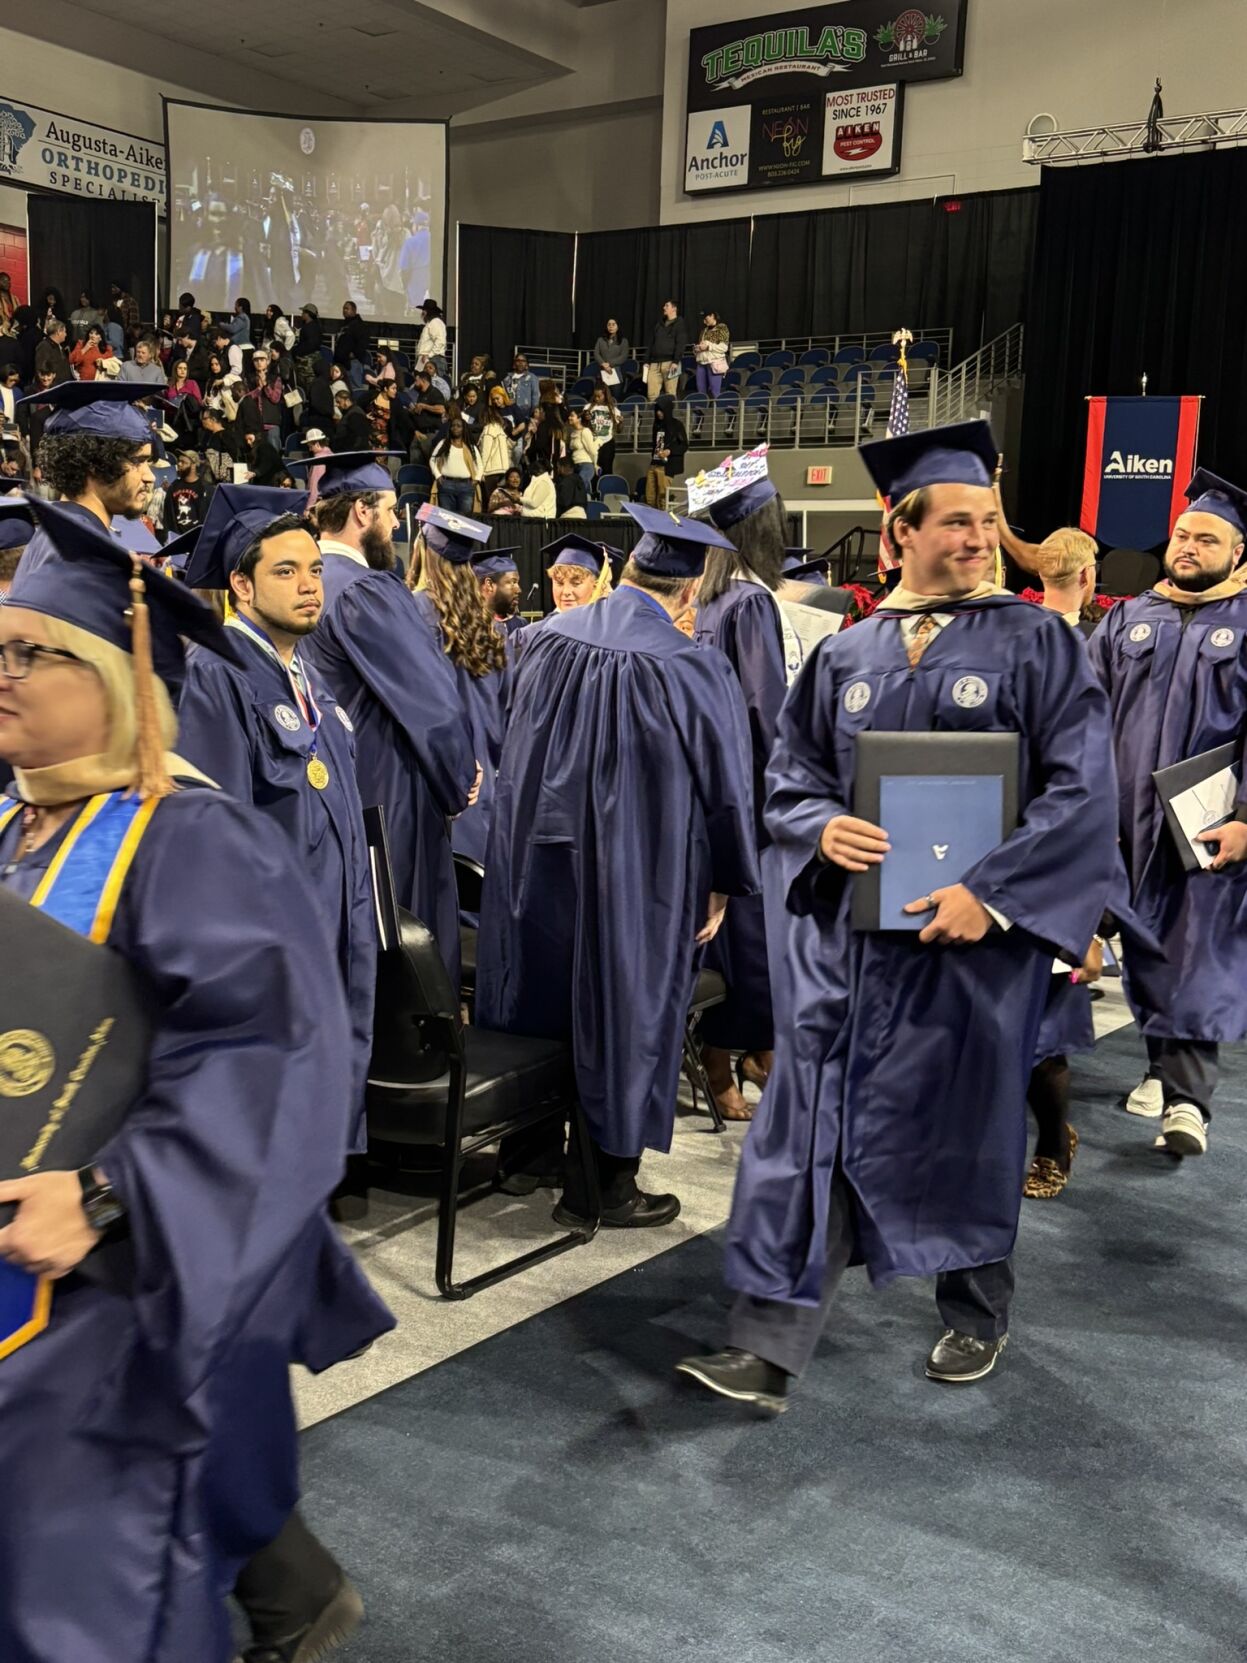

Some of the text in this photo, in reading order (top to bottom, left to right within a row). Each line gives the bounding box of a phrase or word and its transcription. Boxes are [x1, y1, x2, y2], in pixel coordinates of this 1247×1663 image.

[702, 25, 867, 83] TEQUILA'S
[888, 52, 908, 62] GRILL
[913, 49, 928, 59] BAR
[740, 62, 822, 82] MEXICAN RESTAURANT
[826, 88, 895, 108] MOST TRUSTED
[832, 103, 887, 120] SINCE 1967
[837, 122, 880, 137] AIKEN
[45, 121, 165, 170] Augusta-Aike
[852, 138, 876, 147] CONTROL
[41, 147, 165, 195] ORTHOPEDI
[688, 152, 747, 172] Anchor
[695, 170, 738, 181] POST-ACUTE
[1104, 451, 1173, 473] Aiken
[811, 468, 827, 481] EXIT
